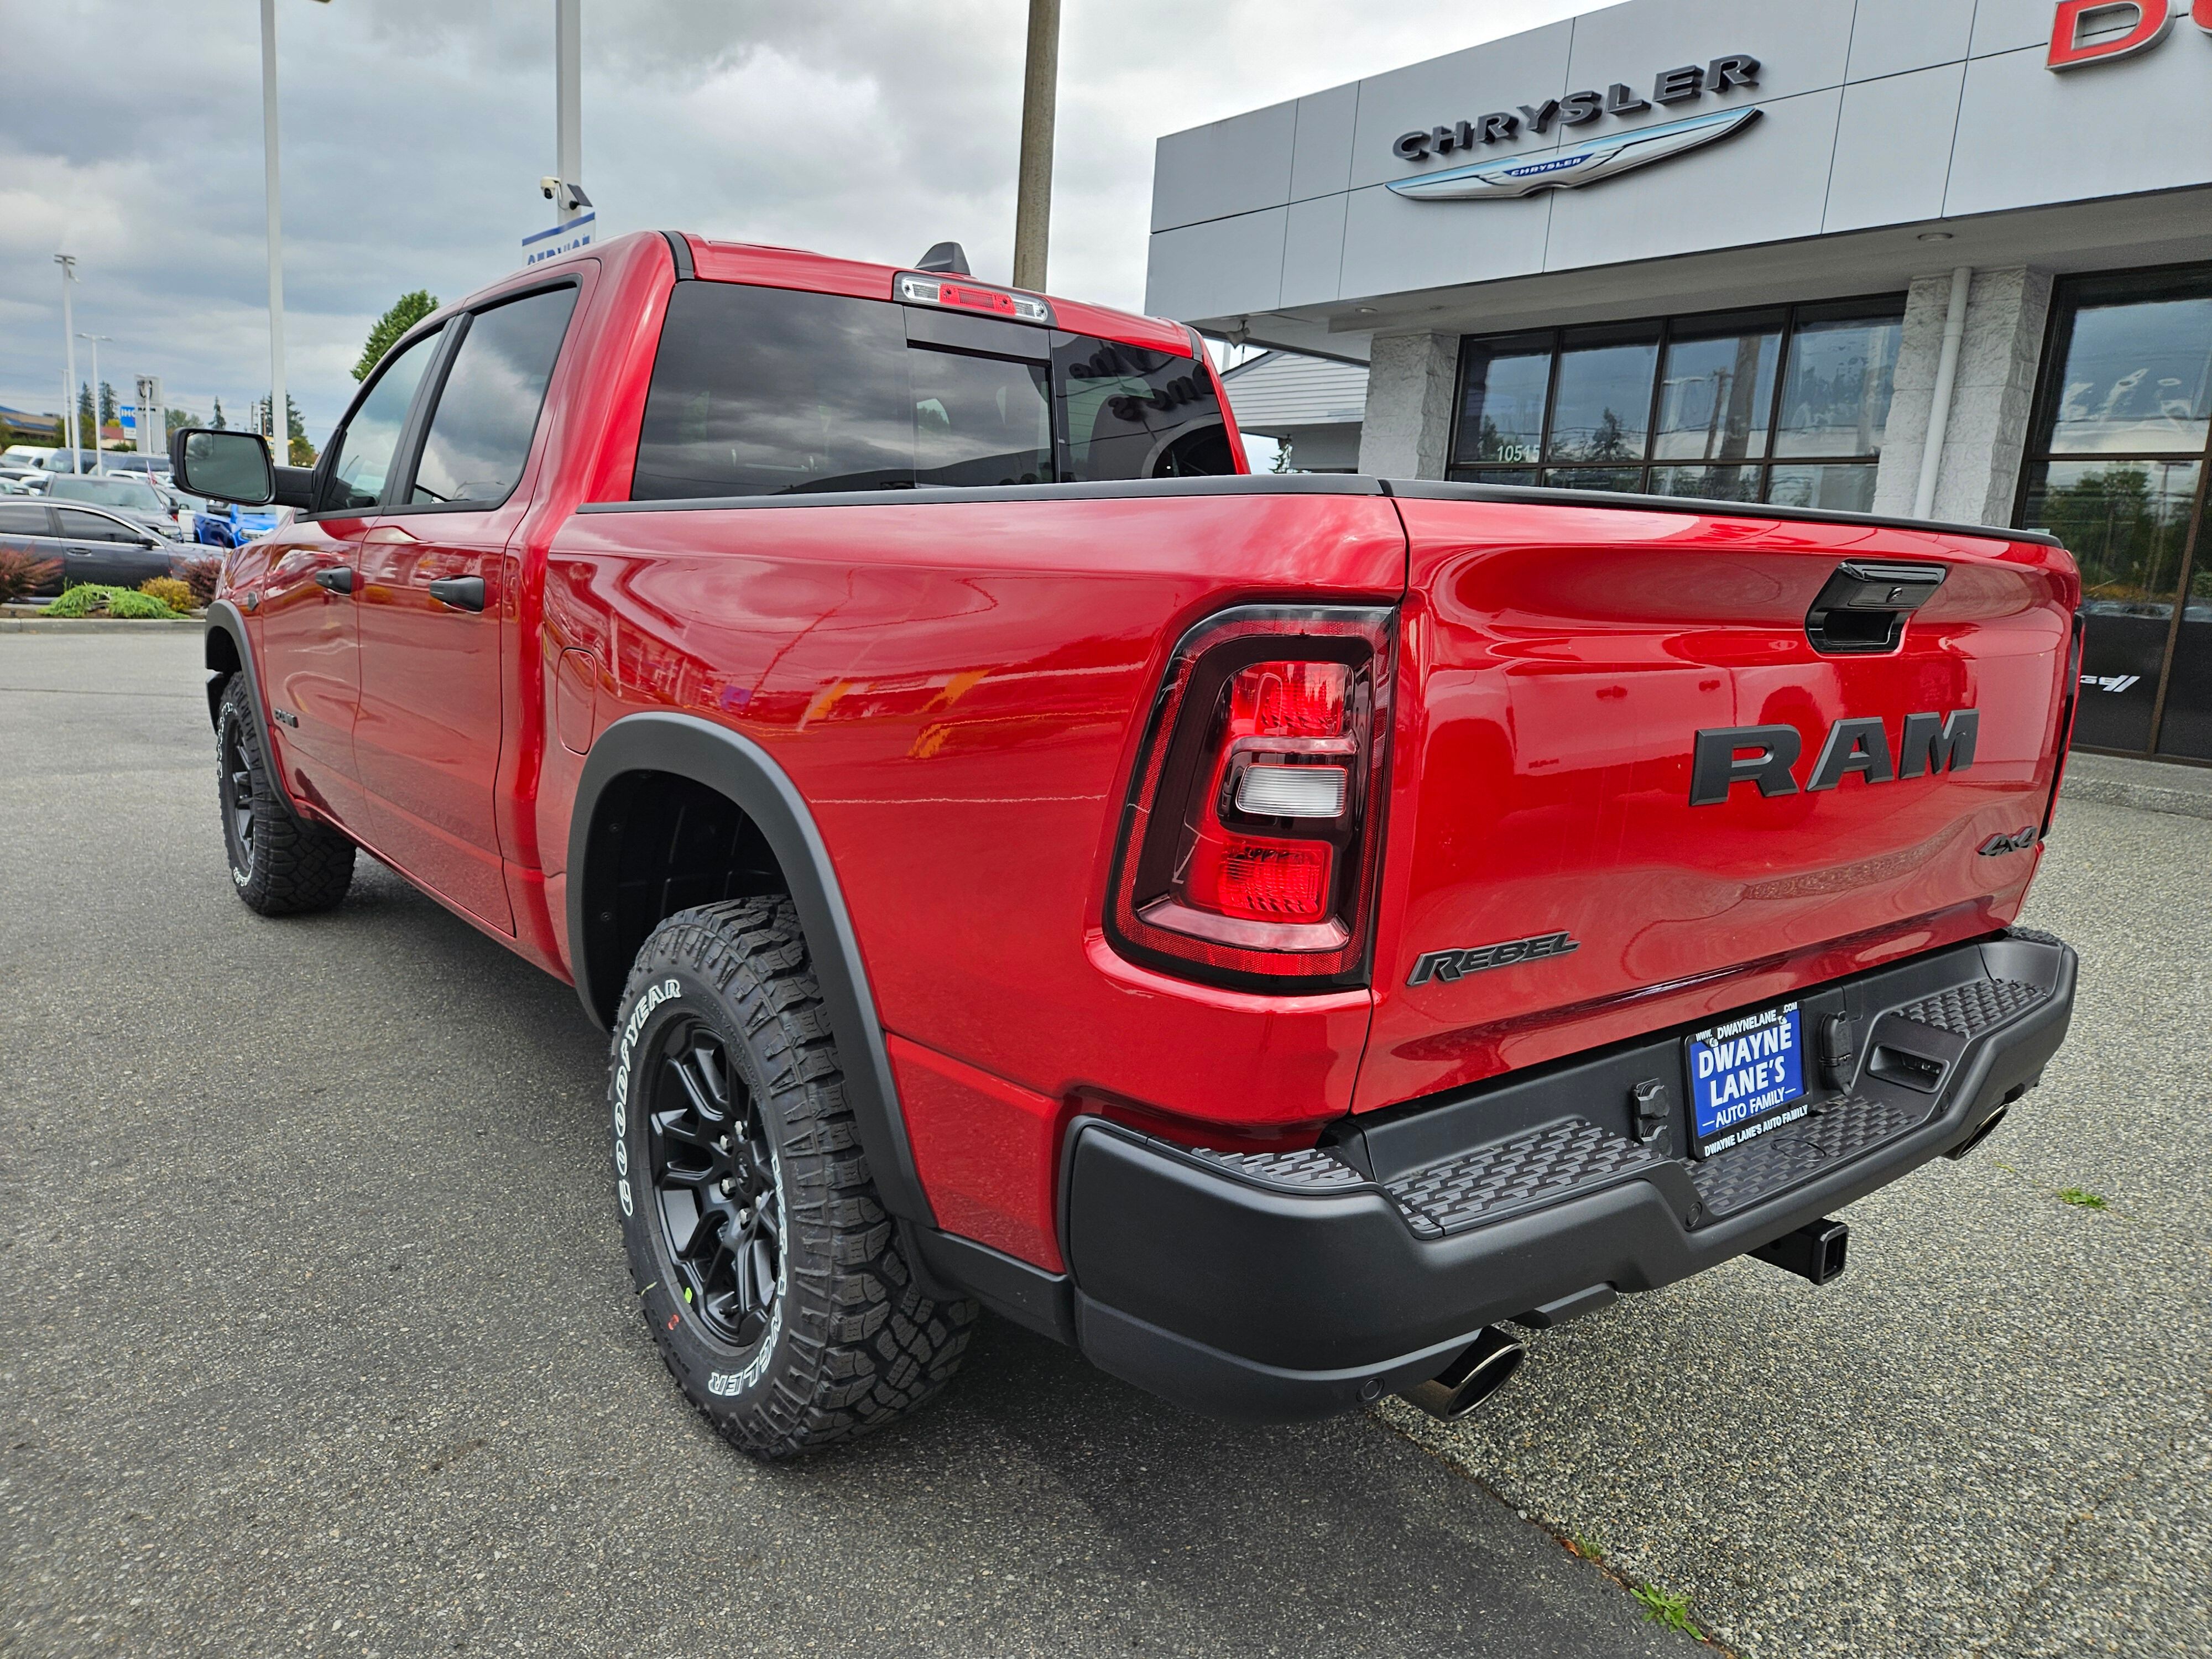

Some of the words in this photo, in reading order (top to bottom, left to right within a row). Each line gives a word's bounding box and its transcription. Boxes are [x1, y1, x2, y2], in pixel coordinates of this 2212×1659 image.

[2044, 0, 2212, 75] D
[1392, 54, 1761, 161] CHRYSLER
[1511, 158, 1582, 176] CHRYSLER
[1497, 444, 1540, 462] 10515
[274, 708, 299, 728] RAM
[1689, 708, 1979, 806] RAM
[1406, 931, 1580, 986] REBEL
[1699, 1023, 1792, 1078] DWAYNE
[1717, 1009, 1777, 1040] DWAYNELANE
[614, 979, 681, 1217] GOODYEAR
[1710, 1056, 1786, 1108] LANE'S
[1715, 1103, 1747, 1128] AUTO
[1750, 1087, 1785, 1114] FAMILY
[1704, 1137, 1736, 1157] DWAYNE
[1737, 1123, 1762, 1143] LANE'S
[1762, 1117, 1782, 1132] AUTO
[1782, 1104, 1808, 1126] FAMILY
[707, 1153, 787, 1396] WRANGLER
